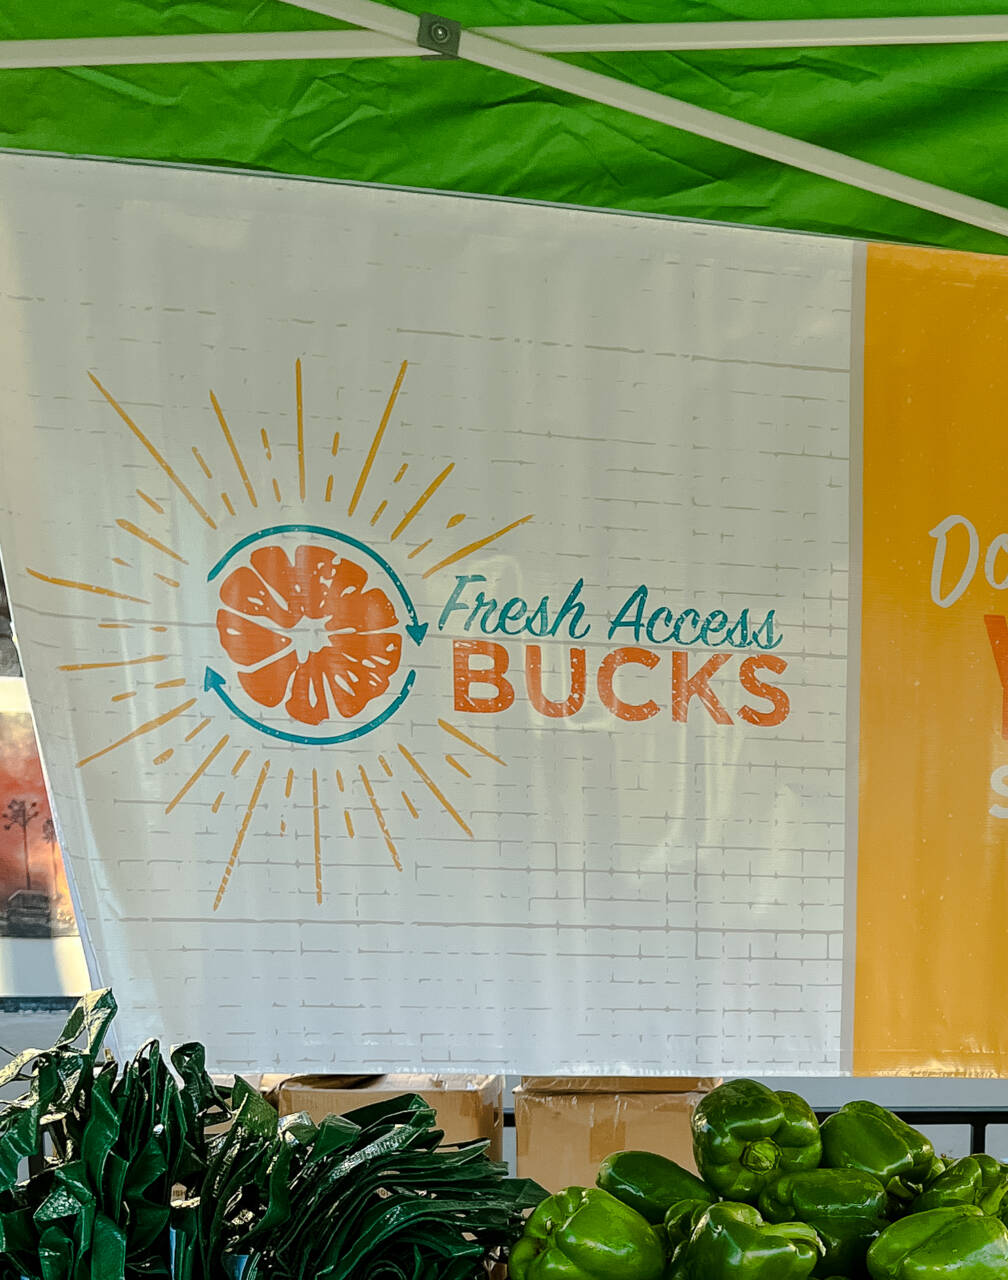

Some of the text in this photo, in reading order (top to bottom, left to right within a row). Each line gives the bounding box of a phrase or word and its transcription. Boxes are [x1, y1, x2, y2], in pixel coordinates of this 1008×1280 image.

[438, 575, 786, 651] Fresh Access
[453, 639, 791, 728] BUCKS
